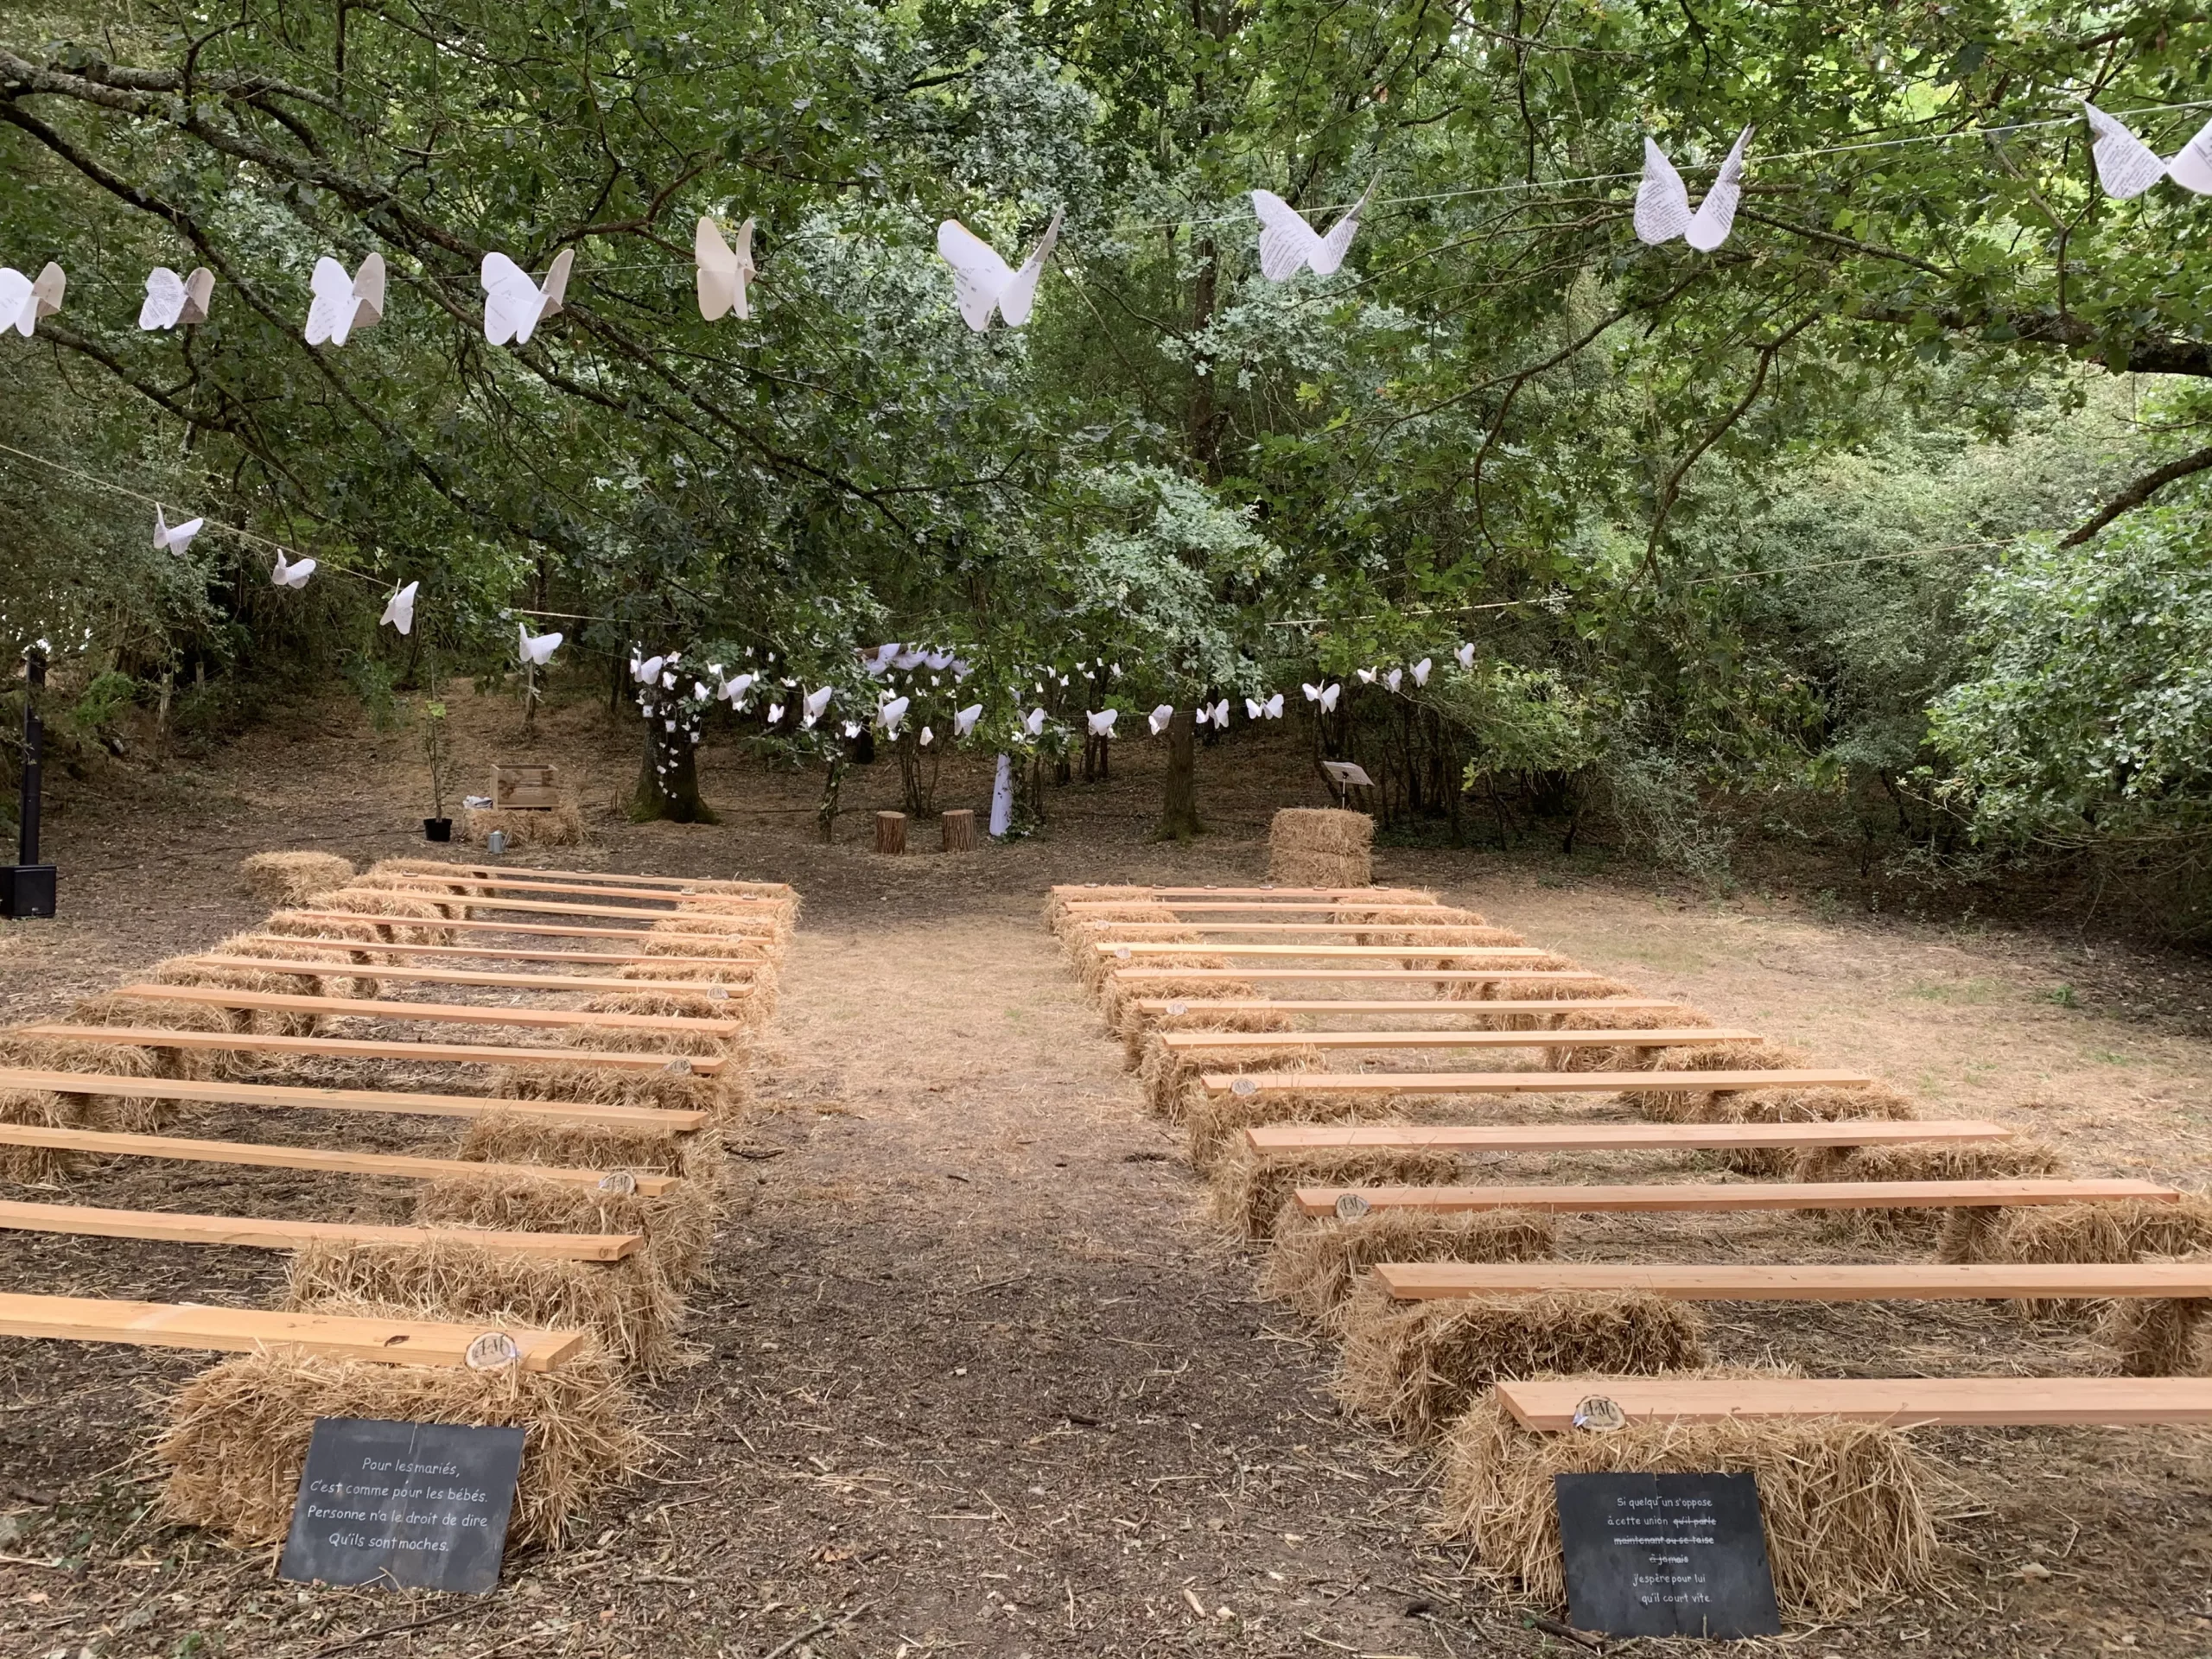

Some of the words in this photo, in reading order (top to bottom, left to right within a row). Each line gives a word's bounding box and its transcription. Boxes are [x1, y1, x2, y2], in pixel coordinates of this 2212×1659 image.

[362, 1458, 391, 1471] Pour
[395, 1459, 412, 1472] les
[309, 1478, 343, 1494] C'est
[346, 1484, 389, 1497] comme
[391, 1486, 423, 1500] pour
[426, 1486, 443, 1500] les
[448, 1486, 488, 1503] bébés.
[1617, 1497, 1626, 1507] Si
[1675, 1498, 1713, 1510] s'oppose
[308, 1505, 366, 1522] Personne
[369, 1510, 387, 1522] n'a
[391, 1511, 402, 1523] le
[405, 1513, 438, 1525] droit
[442, 1513, 457, 1526] de
[461, 1514, 488, 1528] dire
[1615, 1516, 1641, 1526] cette
[1643, 1516, 1668, 1526] union
[1673, 1516, 1692, 1529] qu'il
[1693, 1516, 1717, 1528] parle
[328, 1533, 365, 1548] Qu'ils
[367, 1535, 397, 1549] sont
[398, 1535, 449, 1552] moches.
[1658, 1554, 1688, 1565] jamais
[1632, 1573, 1670, 1586] j'espère
[1671, 1574, 1692, 1586] pour
[1694, 1573, 1706, 1584] lui
[1641, 1592, 1661, 1605] qu'il
[1662, 1593, 1688, 1603] court
